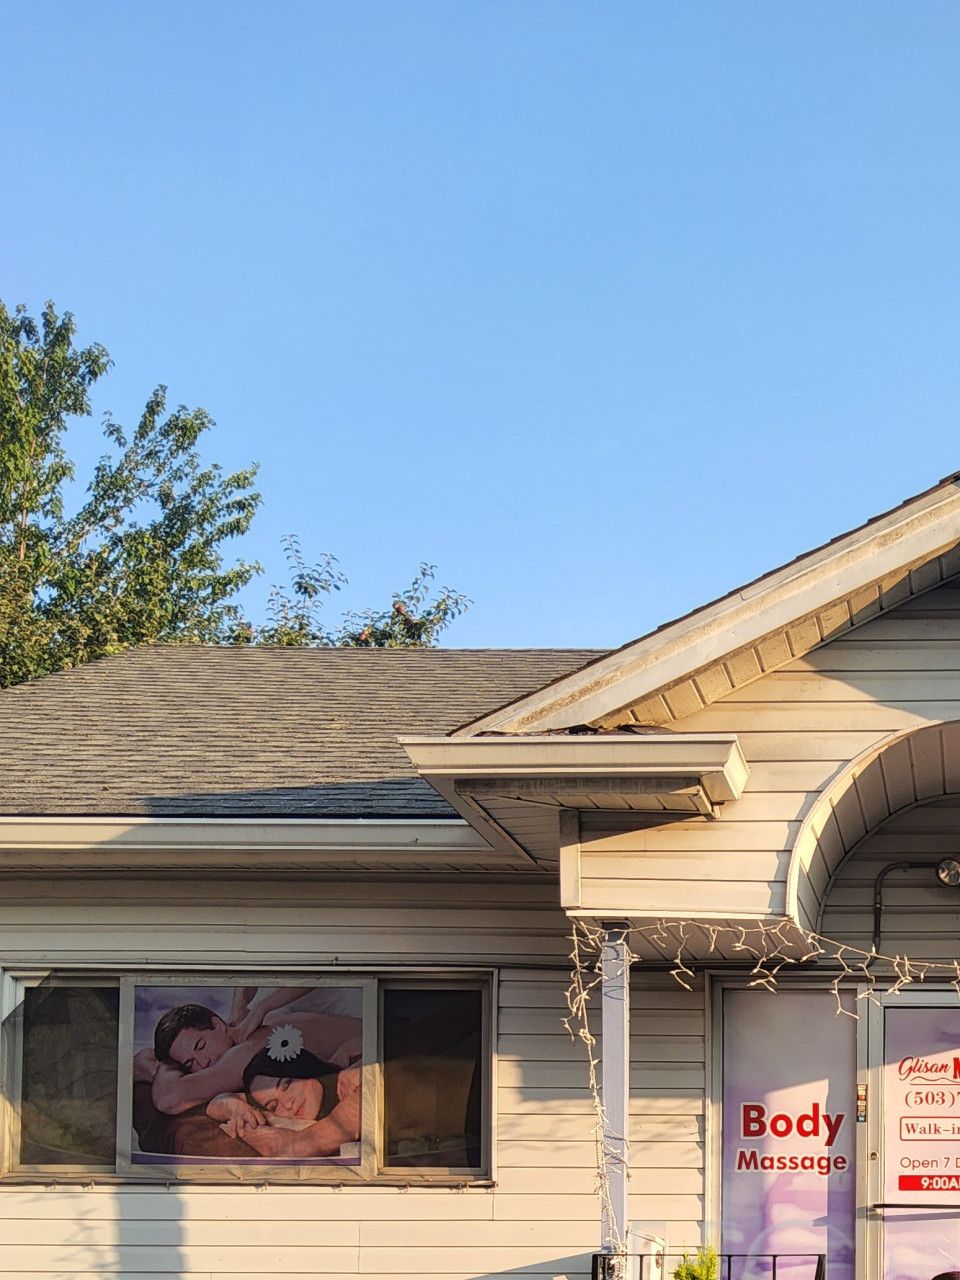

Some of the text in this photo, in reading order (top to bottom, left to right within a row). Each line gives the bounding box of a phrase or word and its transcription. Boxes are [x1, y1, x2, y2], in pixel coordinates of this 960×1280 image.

[898, 1056, 950, 1081] Glisan
[743, 1103, 845, 1146] Body
[738, 1151, 847, 1175] Massage
[900, 1157, 938, 1170] Open
[943, 1157, 951, 1168] 7
